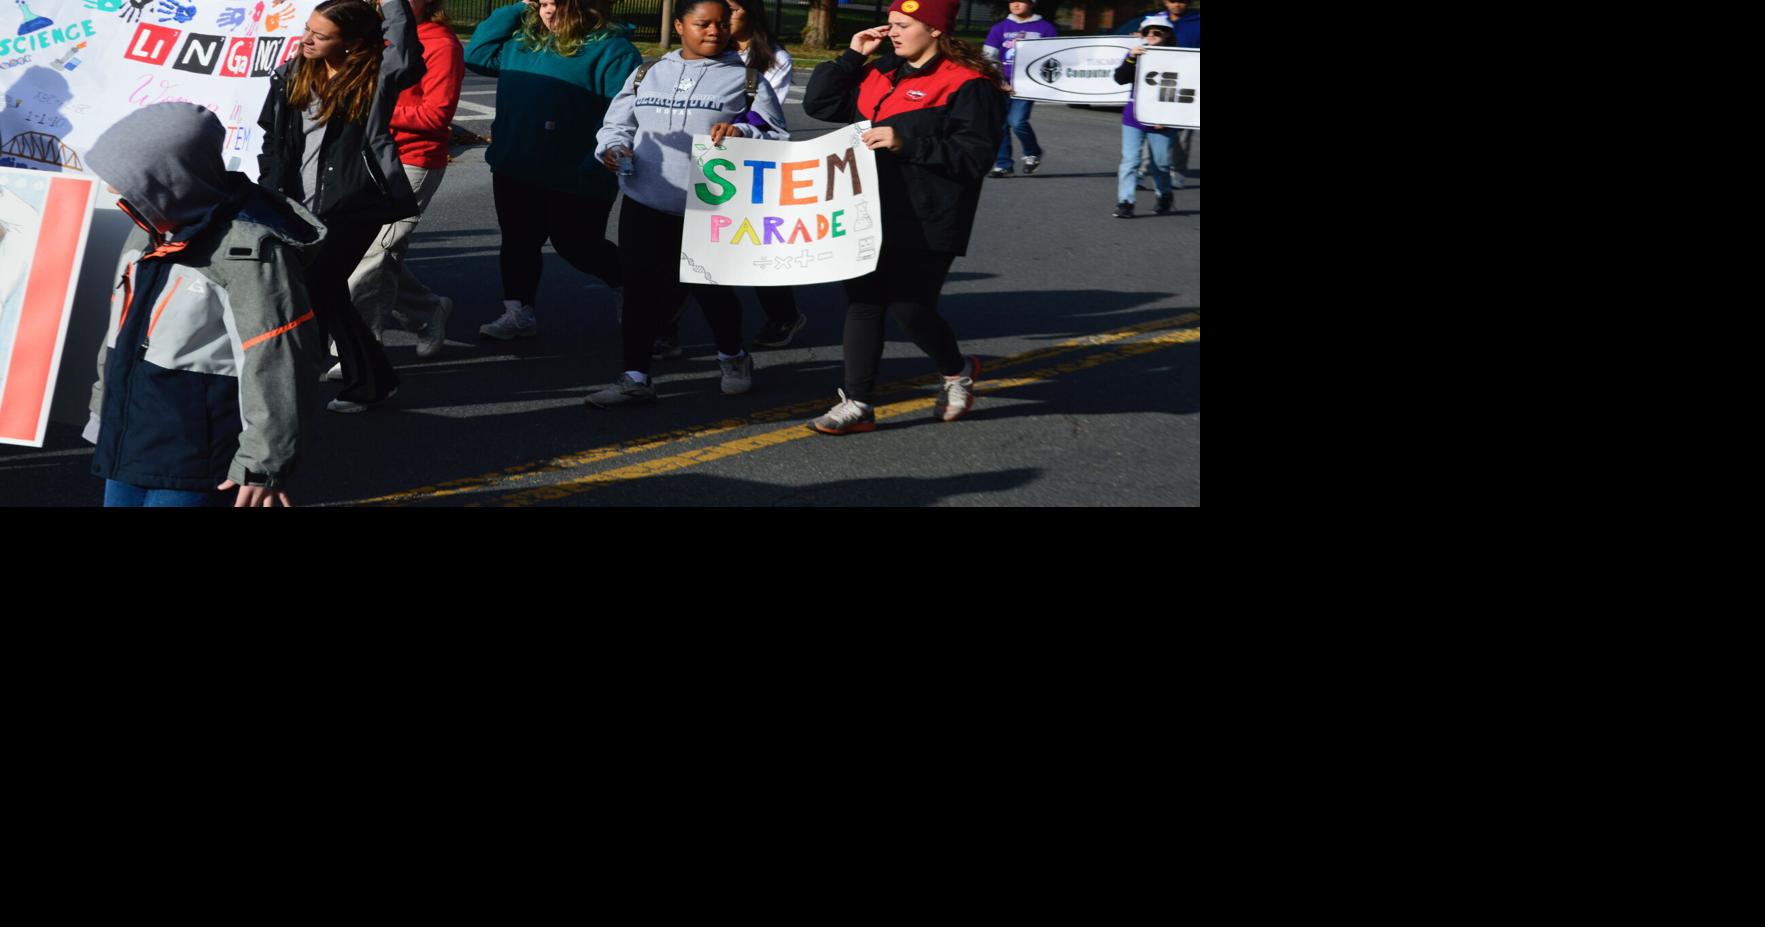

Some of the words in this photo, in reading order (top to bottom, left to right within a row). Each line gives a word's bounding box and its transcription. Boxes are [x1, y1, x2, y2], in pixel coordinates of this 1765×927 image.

[0, 20, 96, 56] SCIENCE
[223, 126, 251, 151] TEM
[694, 147, 863, 206] STEM
[710, 209, 847, 246] PARADE
